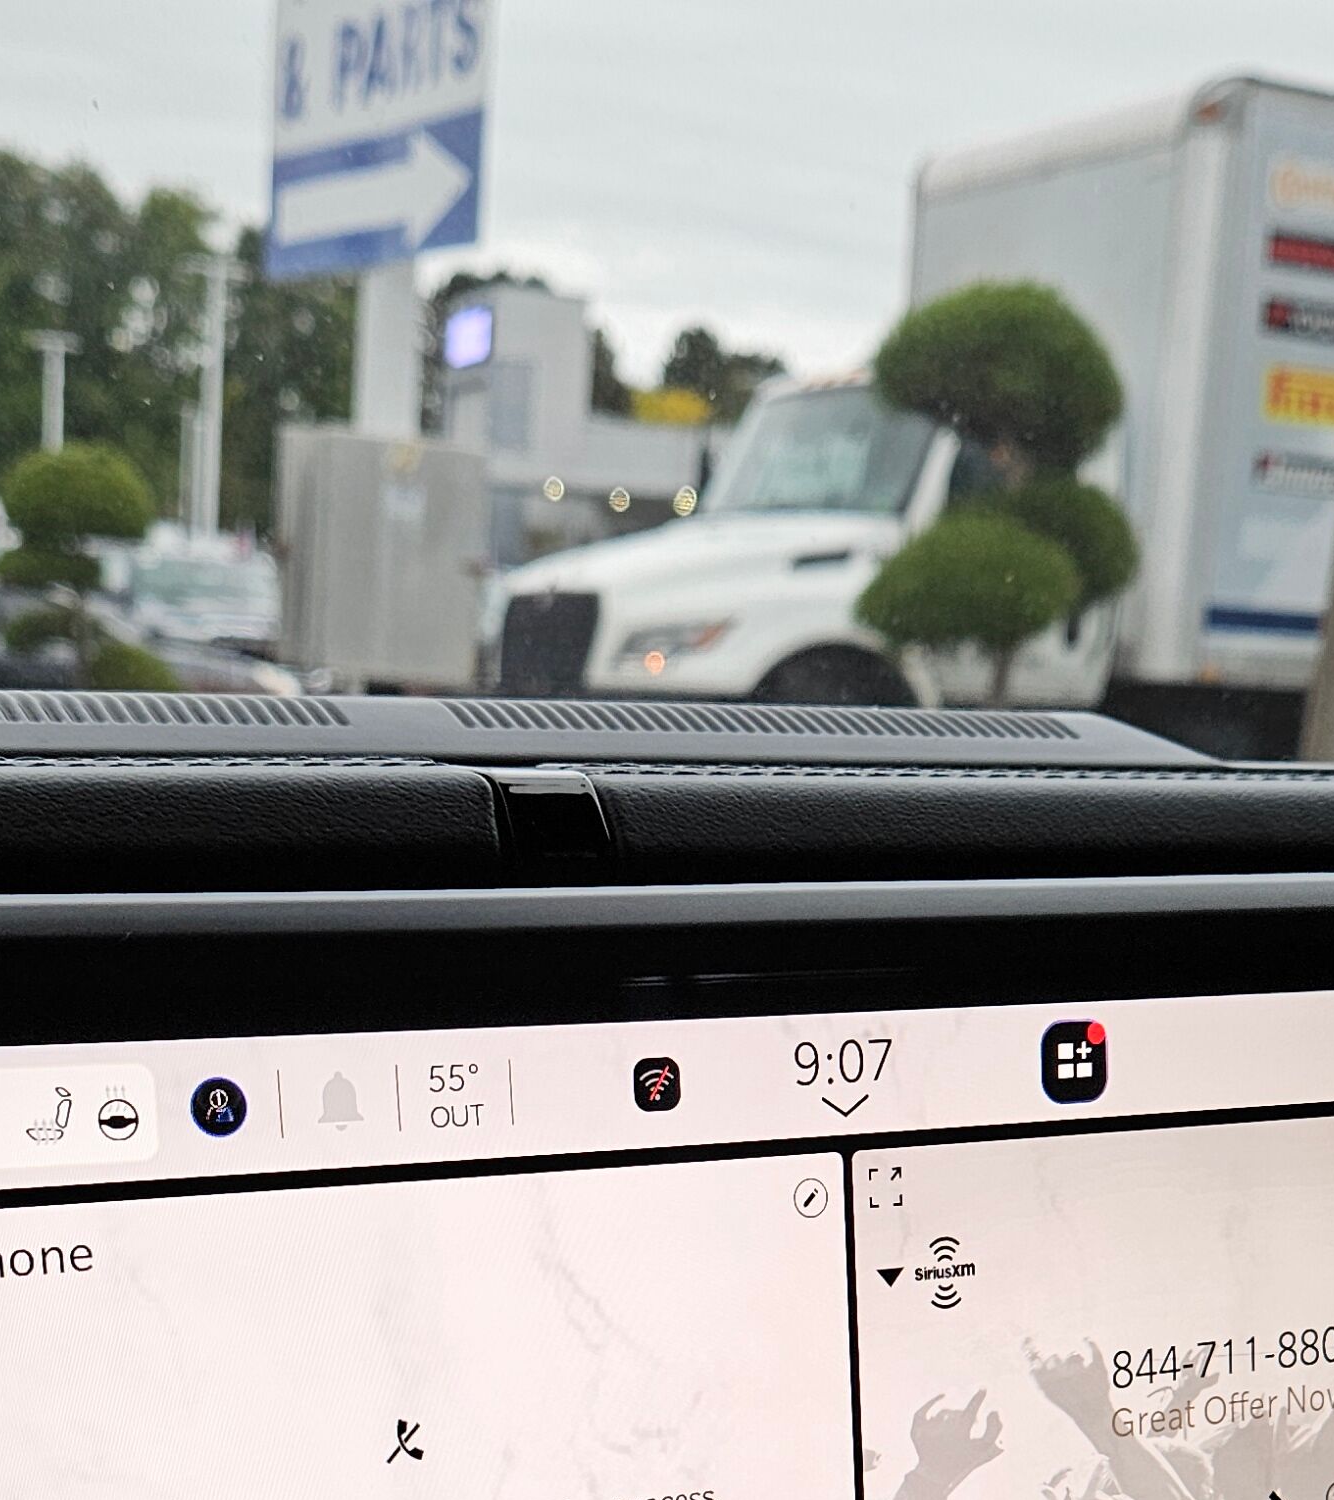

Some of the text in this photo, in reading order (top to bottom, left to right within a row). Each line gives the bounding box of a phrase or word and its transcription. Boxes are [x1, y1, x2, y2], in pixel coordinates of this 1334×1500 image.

[332, 0, 479, 112] PARTS
[795, 1039, 892, 1086] 9:07
[431, 1104, 484, 1128] OUT
[1112, 1401, 1195, 1438] Great
[1204, 1390, 1278, 1425] Offer
